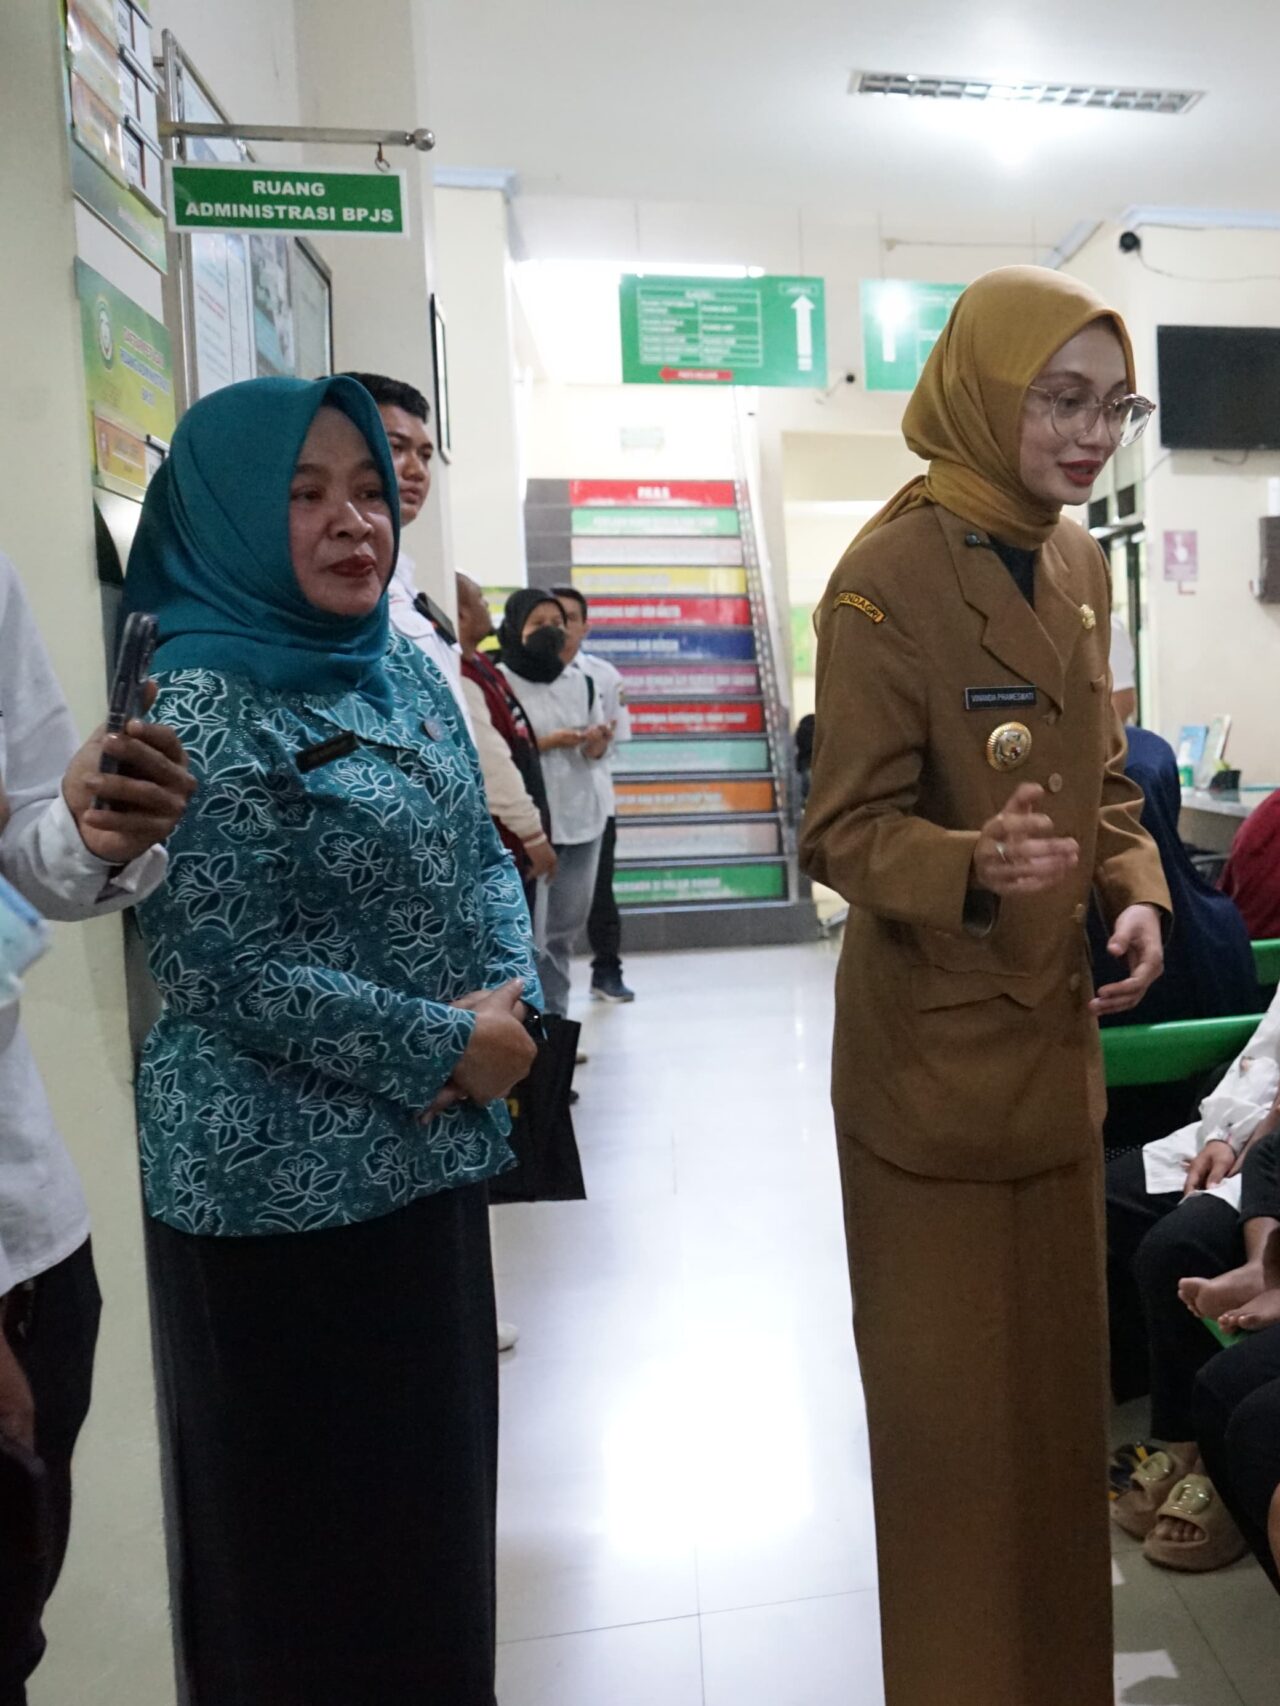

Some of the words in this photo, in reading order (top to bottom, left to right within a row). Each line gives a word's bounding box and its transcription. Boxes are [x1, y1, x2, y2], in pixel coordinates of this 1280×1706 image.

[253, 180, 325, 197] RUANG
[185, 202, 336, 221] ADMINISTRASI
[342, 208, 394, 223] BPJS
